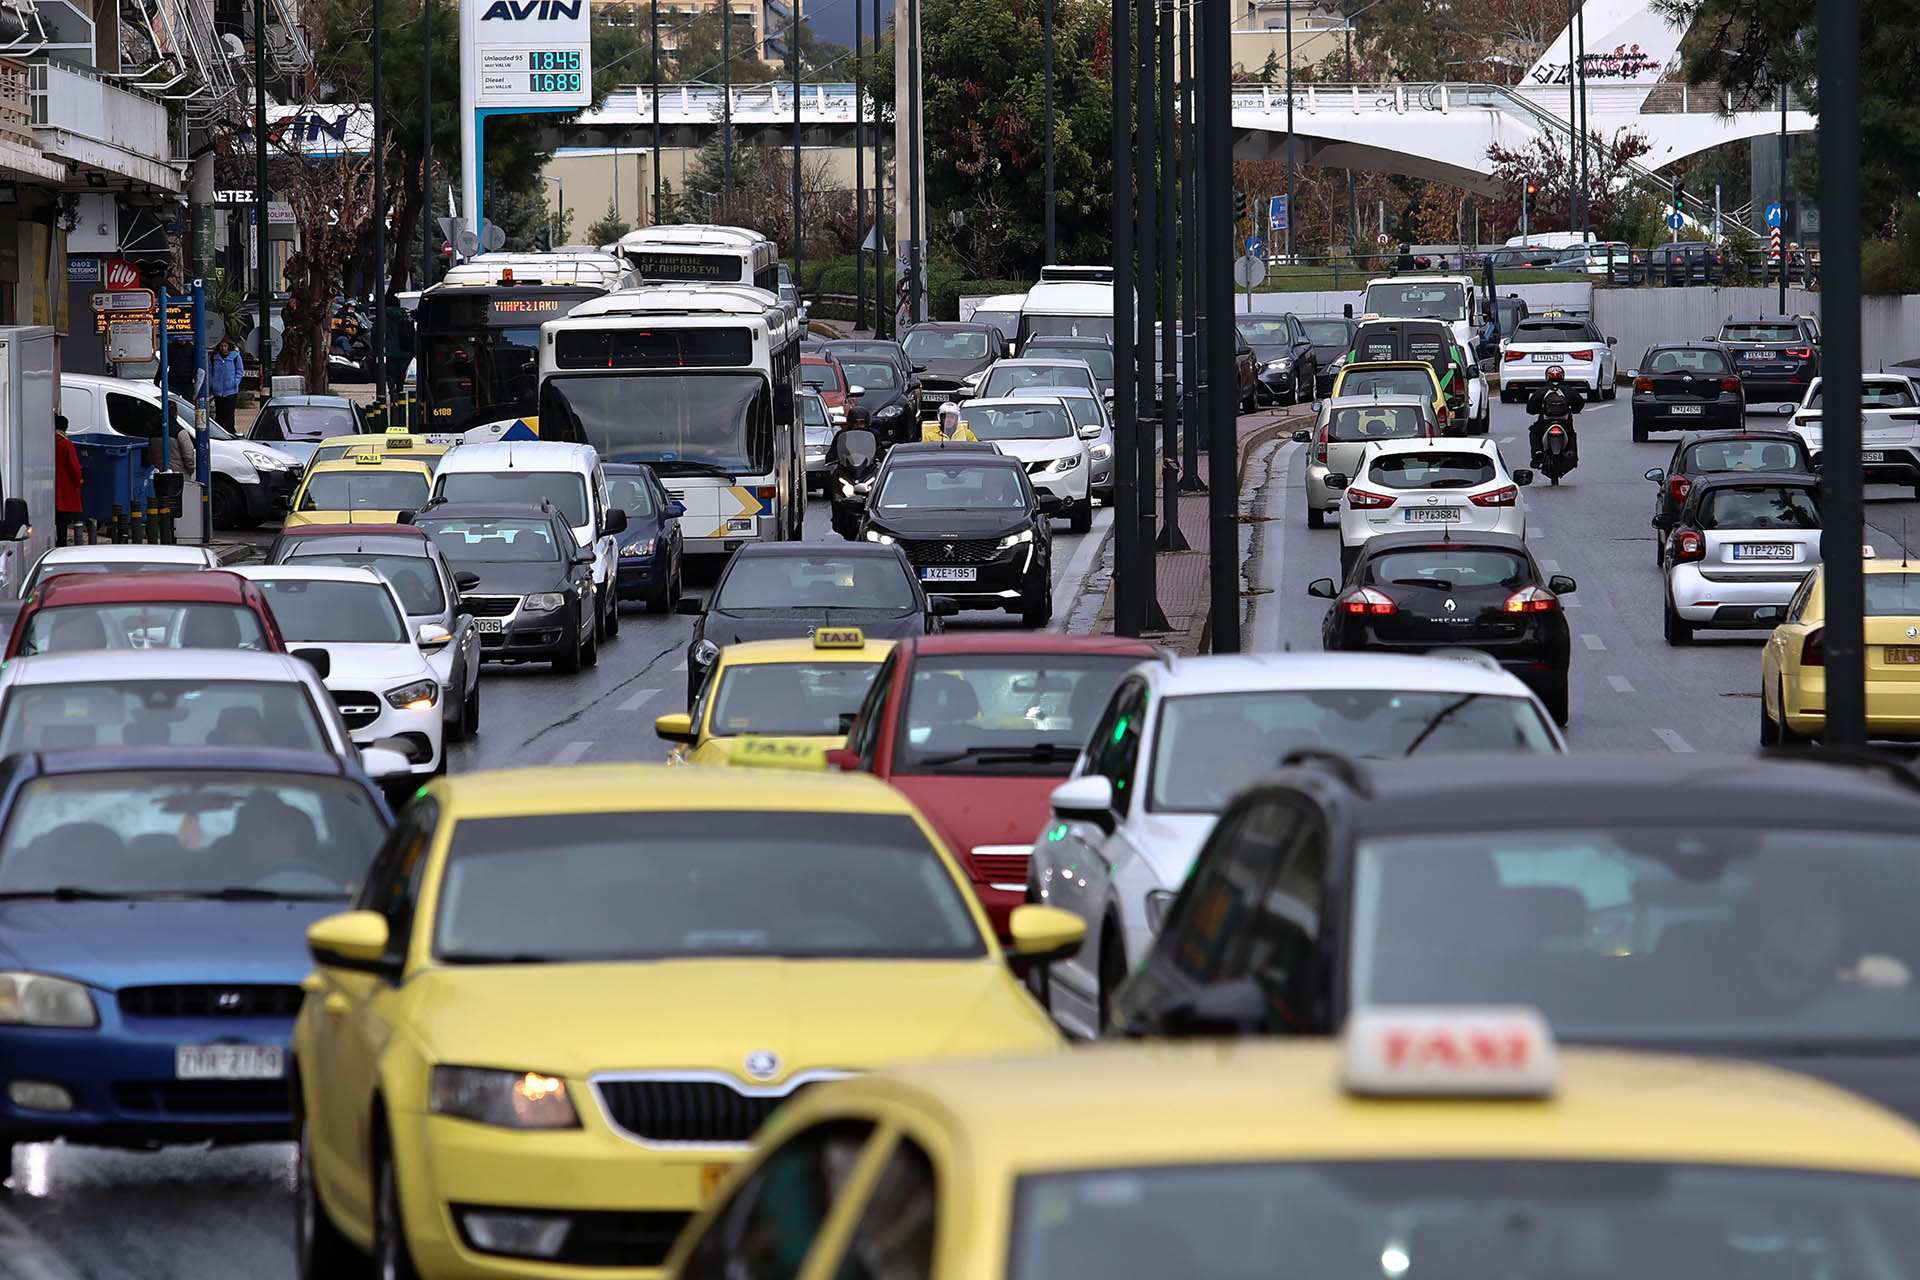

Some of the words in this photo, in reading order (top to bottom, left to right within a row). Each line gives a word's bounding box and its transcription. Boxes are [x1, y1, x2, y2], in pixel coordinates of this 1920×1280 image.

[480, 0, 582, 21] AVIN
[532, 52, 580, 70] 1.845
[533, 74, 580, 92] 1.689
[109, 264, 137, 287] illy
[821, 632, 859, 642] TAXI
[743, 741, 812, 755] TAXI
[1382, 1026, 1531, 1073] TAXI
